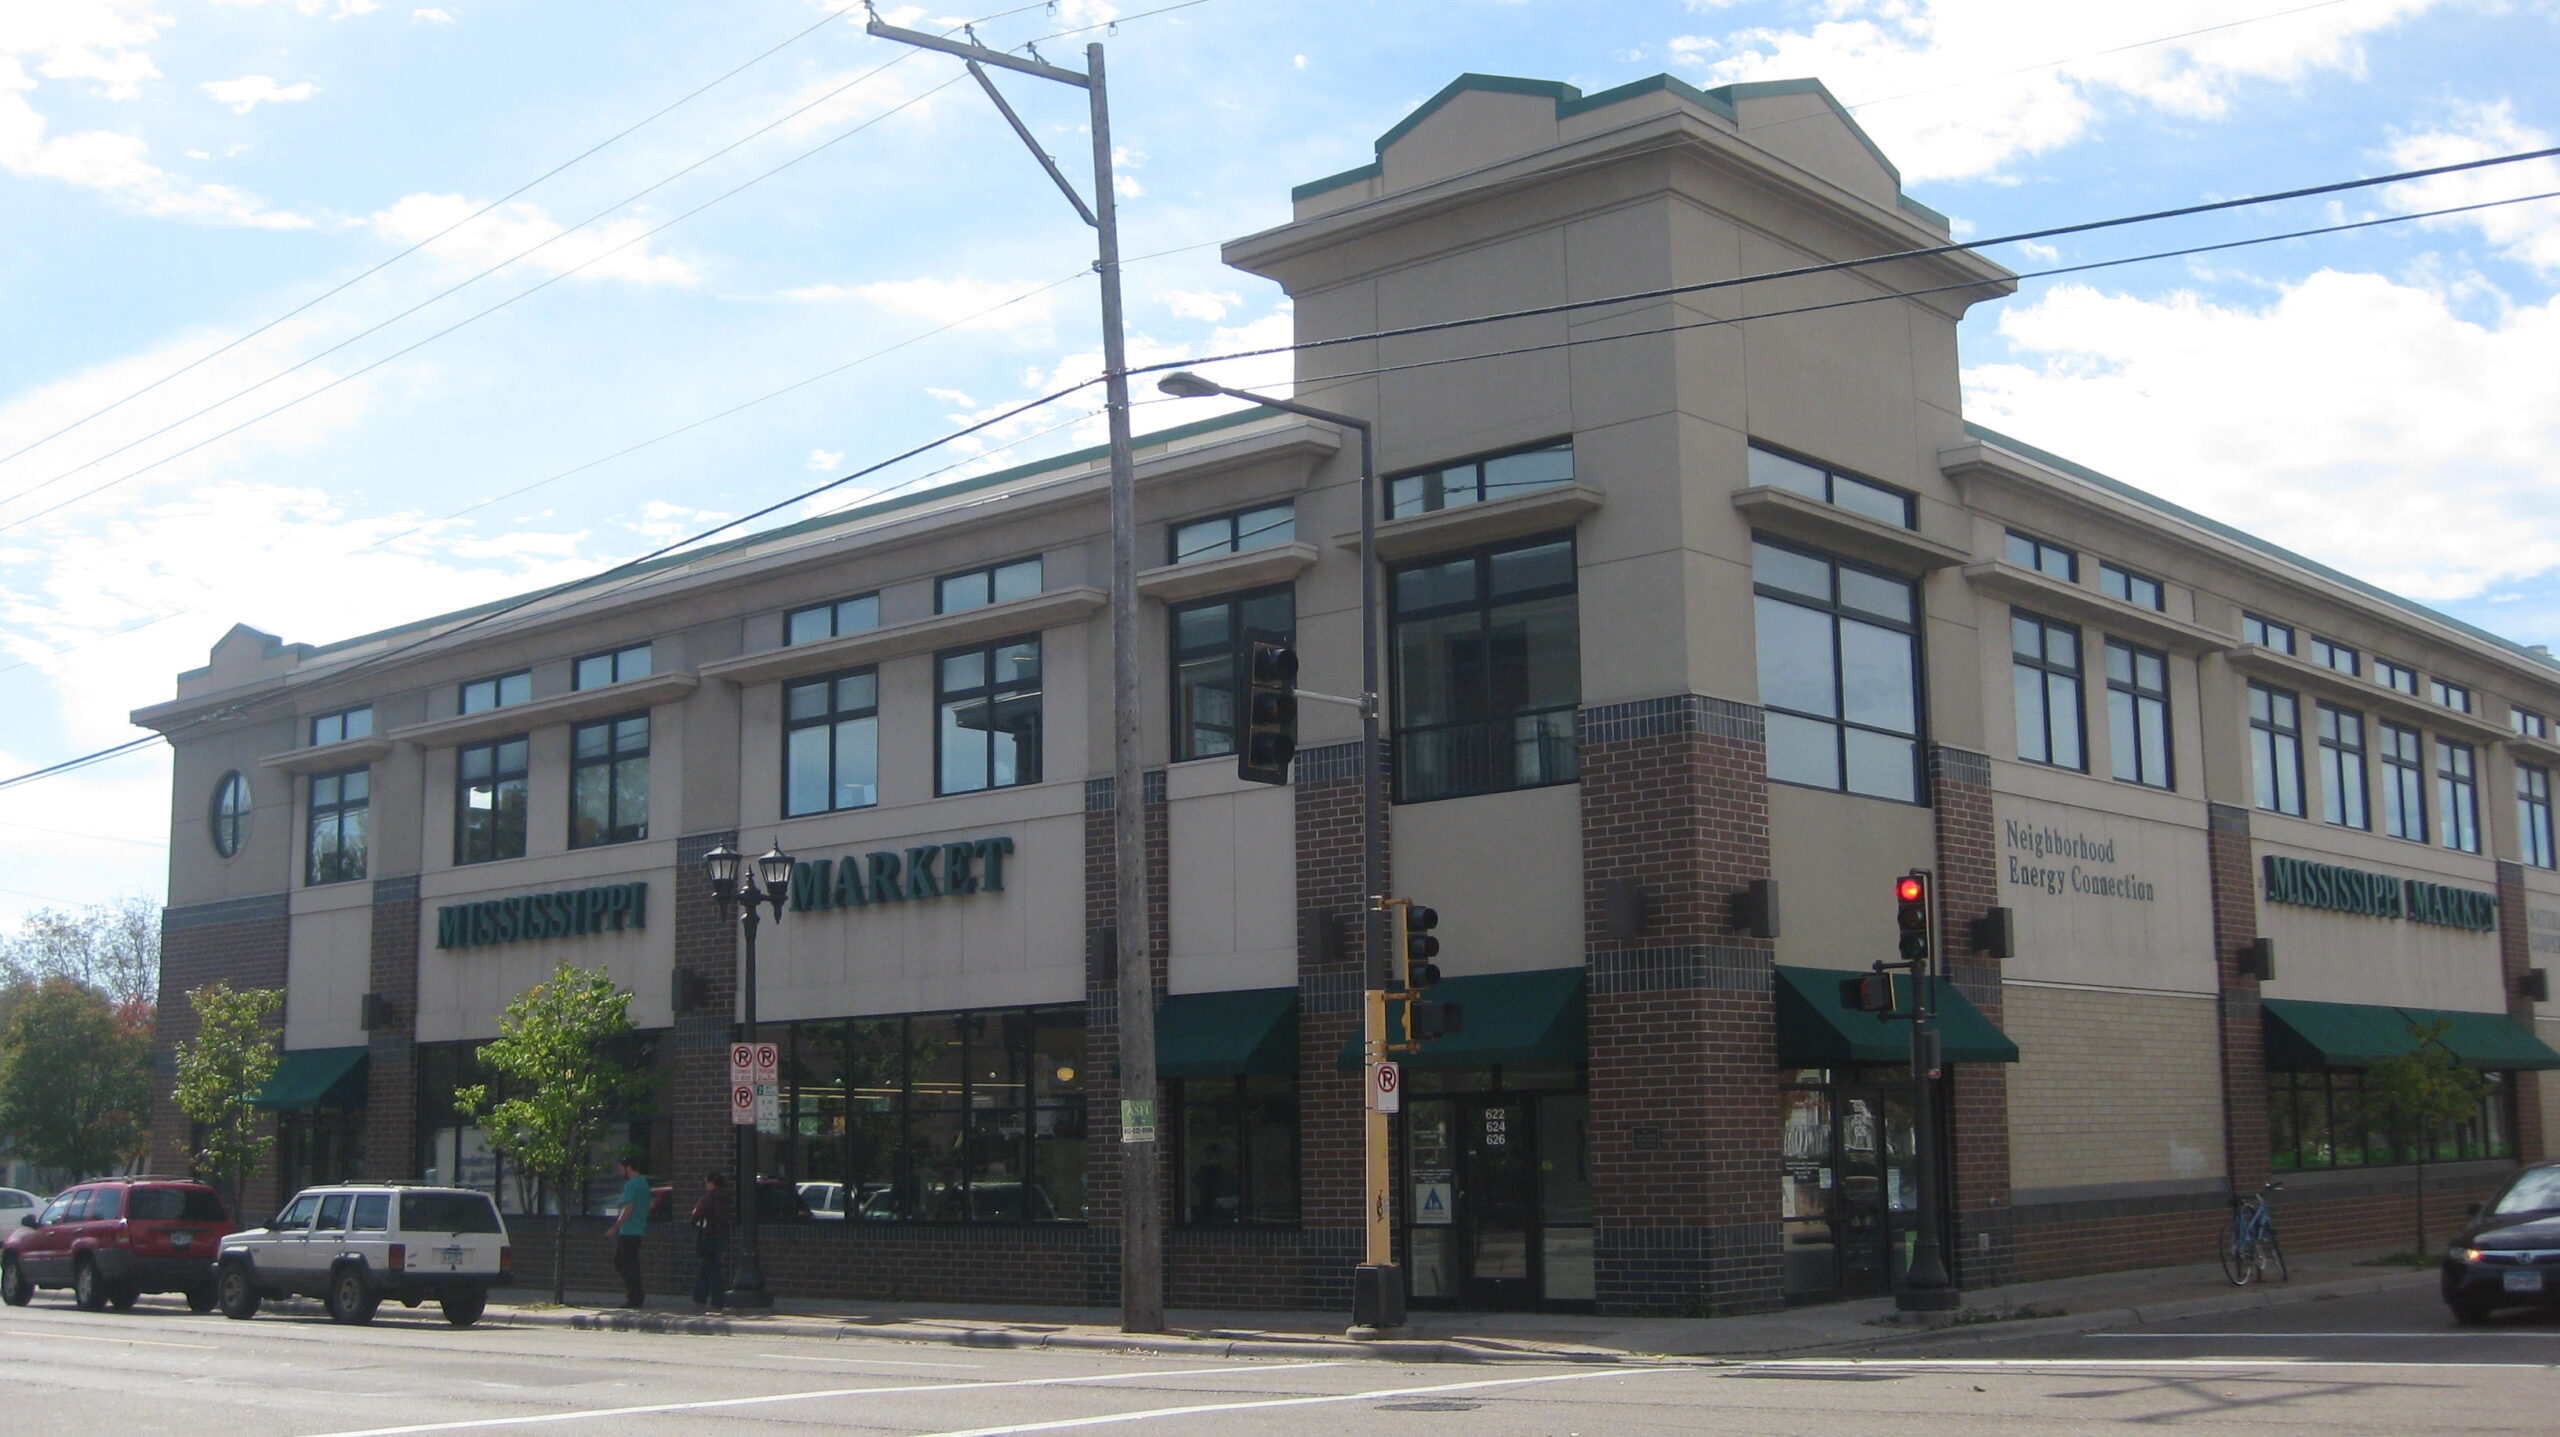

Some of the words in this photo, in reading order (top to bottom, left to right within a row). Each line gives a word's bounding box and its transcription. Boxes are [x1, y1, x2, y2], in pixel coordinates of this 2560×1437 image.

[2006, 819, 2114, 863] Neighborhood
[789, 837, 1015, 912] MARKET
[2009, 855, 2065, 894] Energy
[2071, 865, 2154, 901] Connection
[2263, 855, 2404, 920] MISSISSIPPI
[2404, 880, 2498, 932] MARKET
[437, 882, 648, 948] MISSISSIPPI
[1486, 1109, 1505, 1119] 622
[1487, 1121, 1505, 1132] 624
[1487, 1134, 1505, 1145] 626
